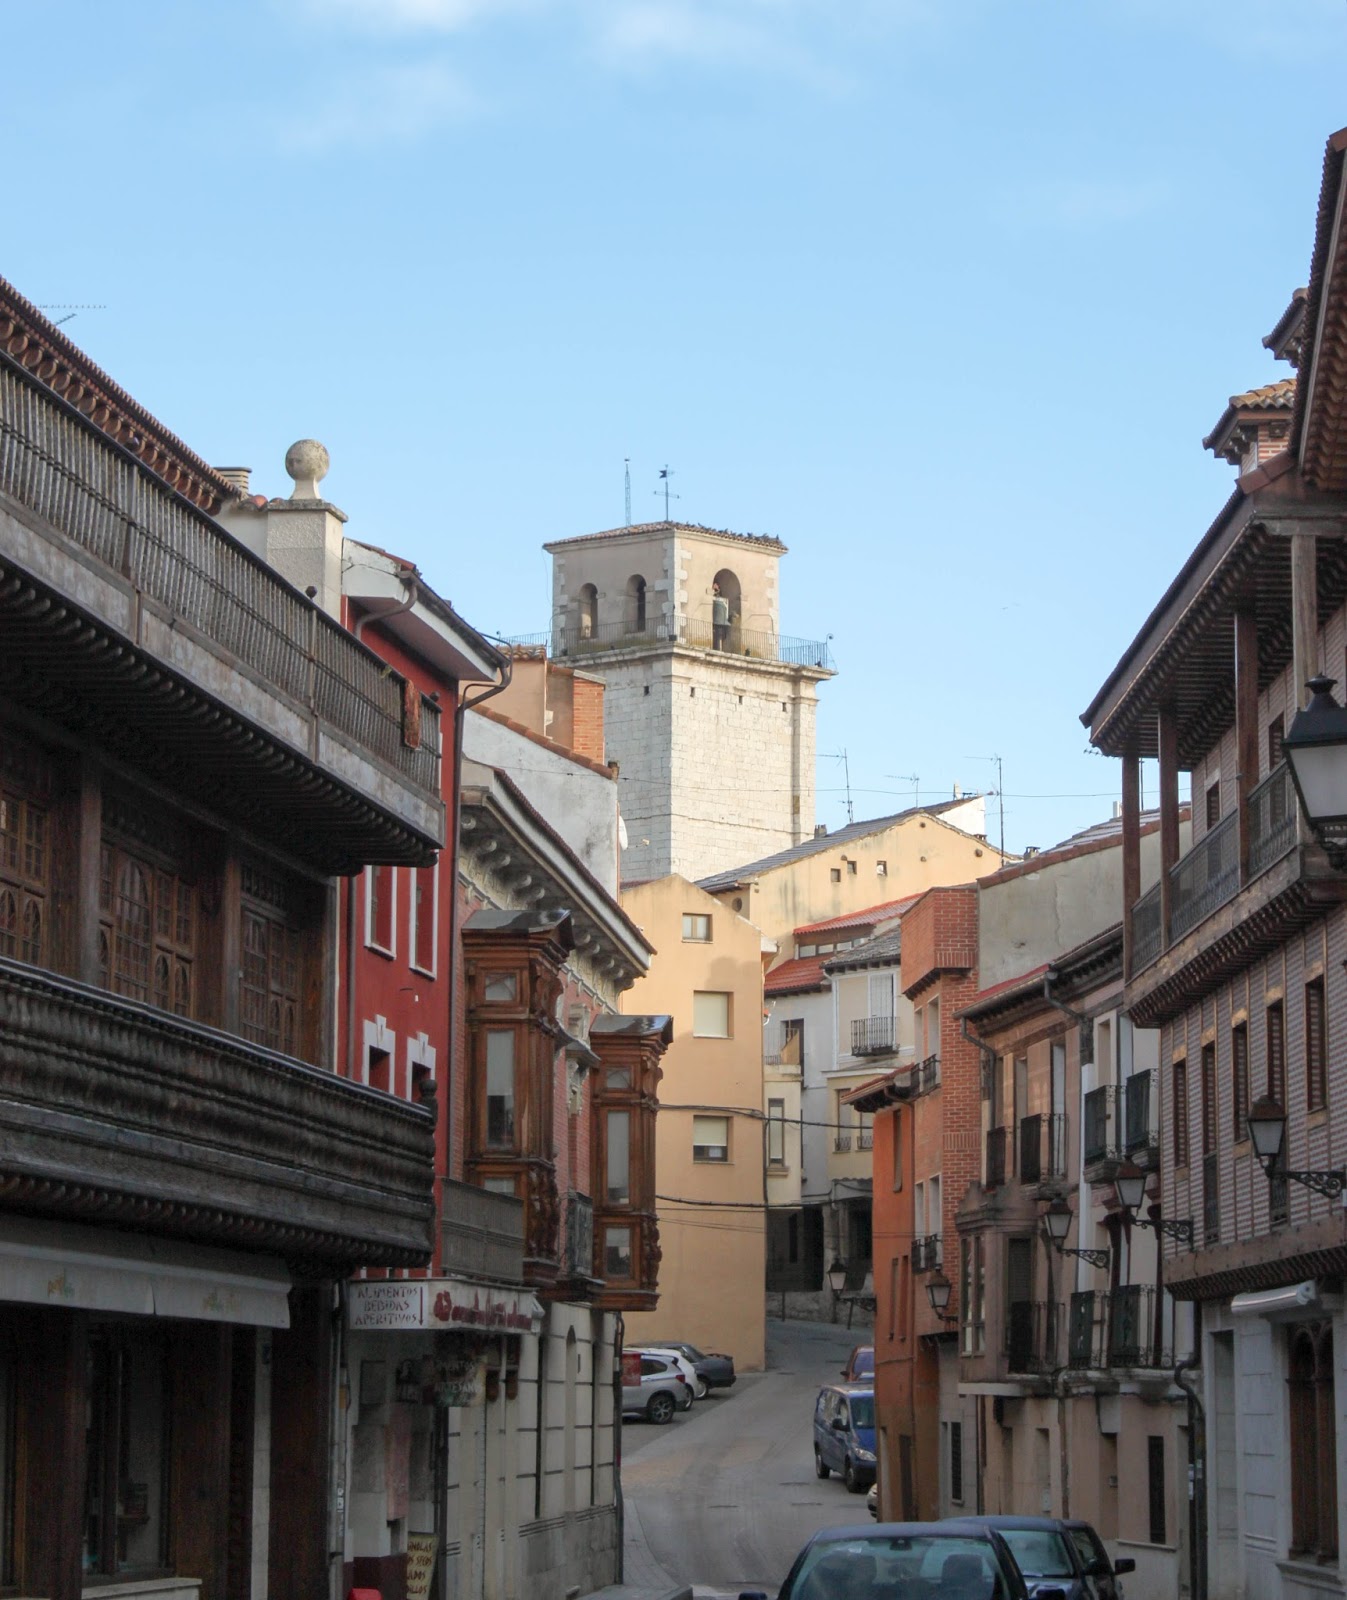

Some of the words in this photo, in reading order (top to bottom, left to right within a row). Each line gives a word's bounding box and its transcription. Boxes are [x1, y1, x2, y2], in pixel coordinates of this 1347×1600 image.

[357, 1285, 418, 1299] ALIMENTOS
[364, 1300, 410, 1312] BEBIDAS
[354, 1313, 417, 1326] APERITIVOS
